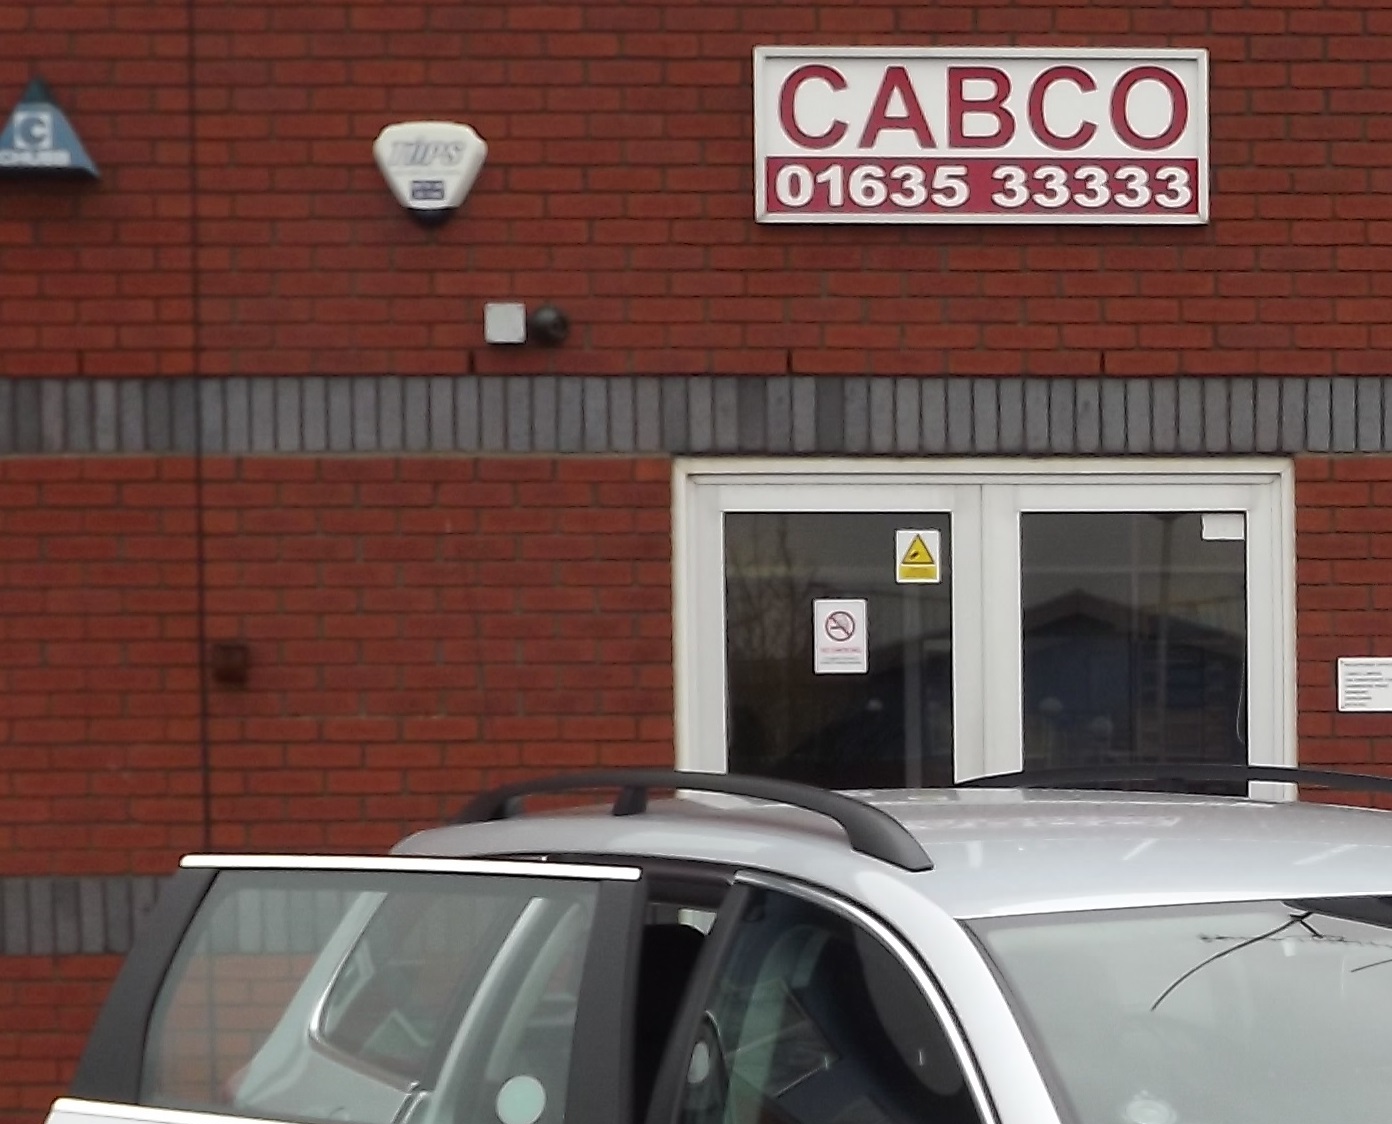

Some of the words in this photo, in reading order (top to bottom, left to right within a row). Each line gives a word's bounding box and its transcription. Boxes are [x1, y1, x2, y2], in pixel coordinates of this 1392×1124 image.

[778, 64, 1190, 151] CABCO
[775, 164, 971, 208] 01635
[991, 164, 1192, 209] 33333
